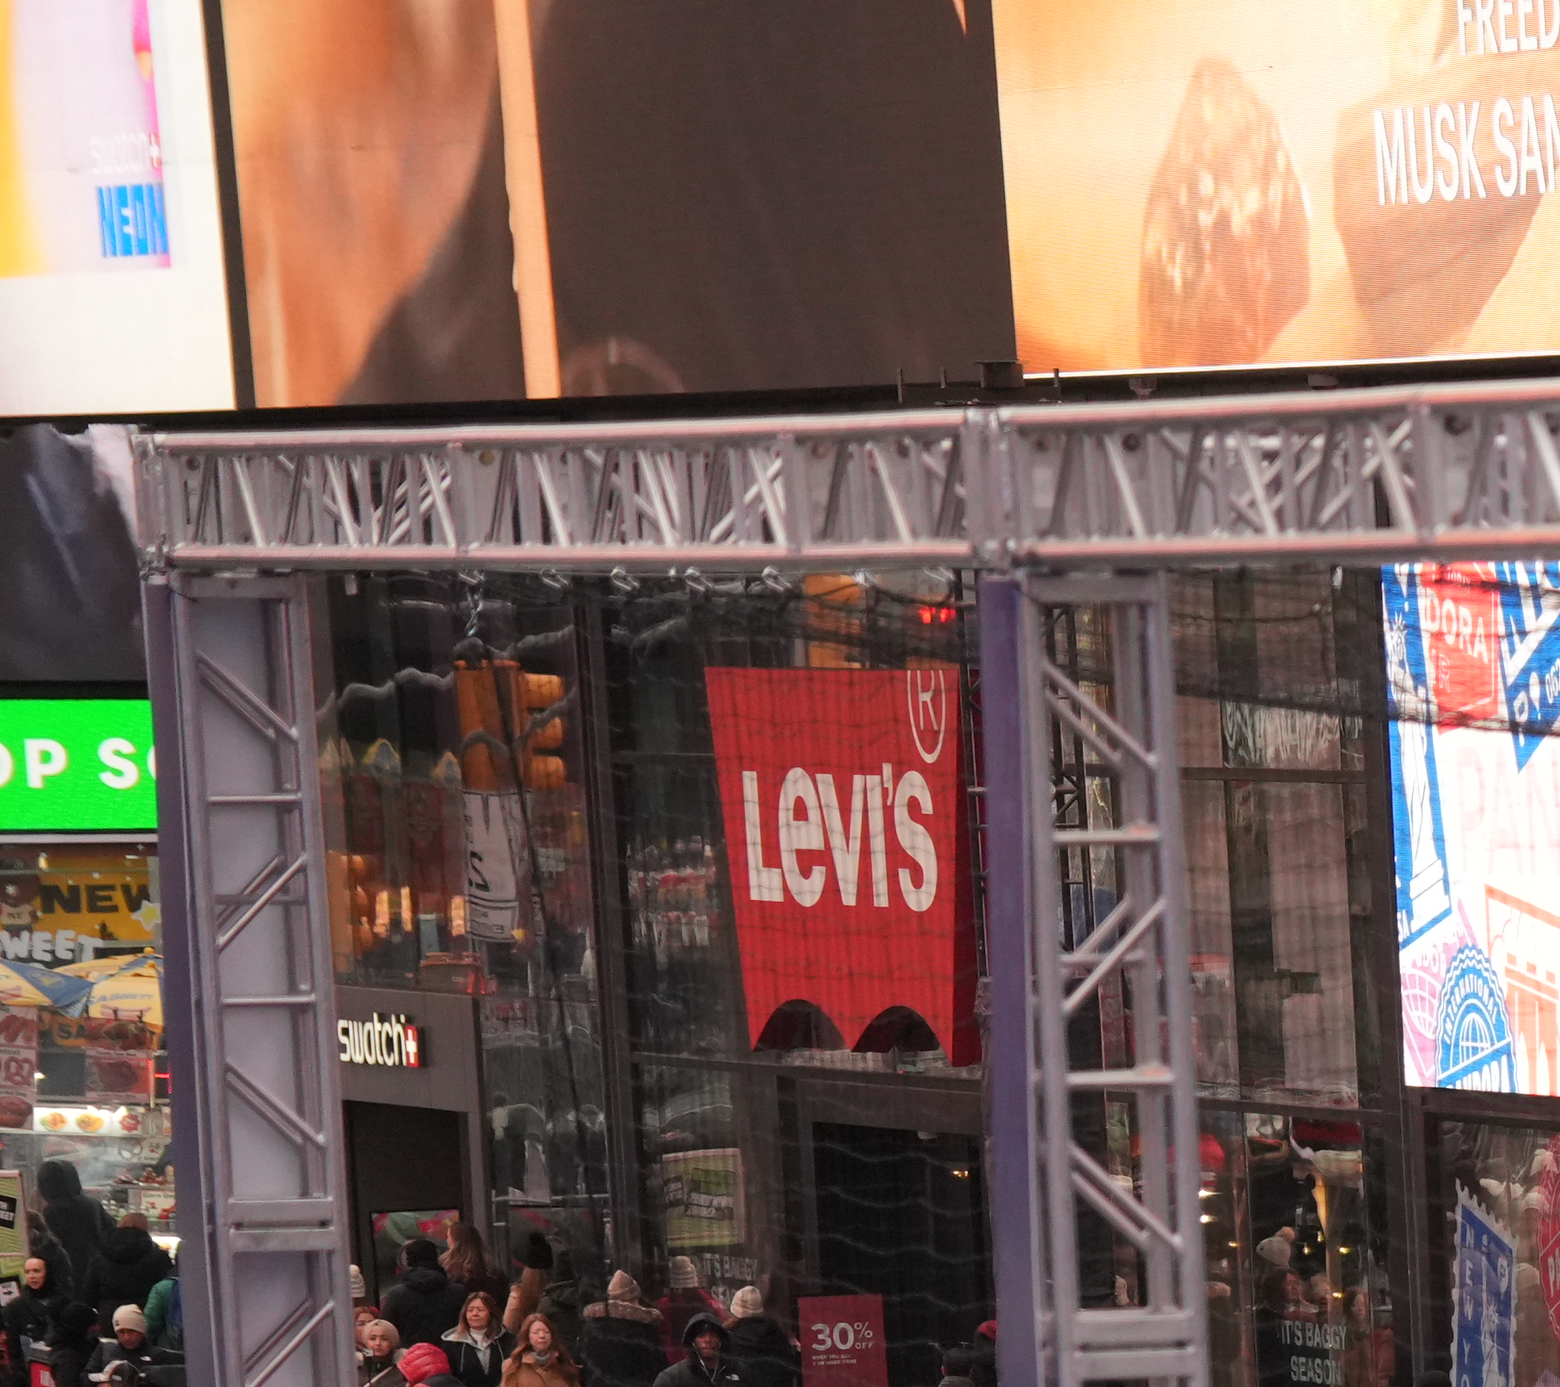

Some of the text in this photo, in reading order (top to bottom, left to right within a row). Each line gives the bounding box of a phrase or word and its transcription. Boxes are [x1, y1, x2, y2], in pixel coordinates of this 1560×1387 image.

[1374, 107, 1488, 206] MUSK
[1442, 969, 1501, 1044] INTERNATIONAL
[337, 1012, 407, 1067] swatch
[811, 1321, 874, 1351] 30%
[1280, 1320, 1348, 1351] IT'S BAGGY
[1289, 1354, 1343, 1387] SEASON
